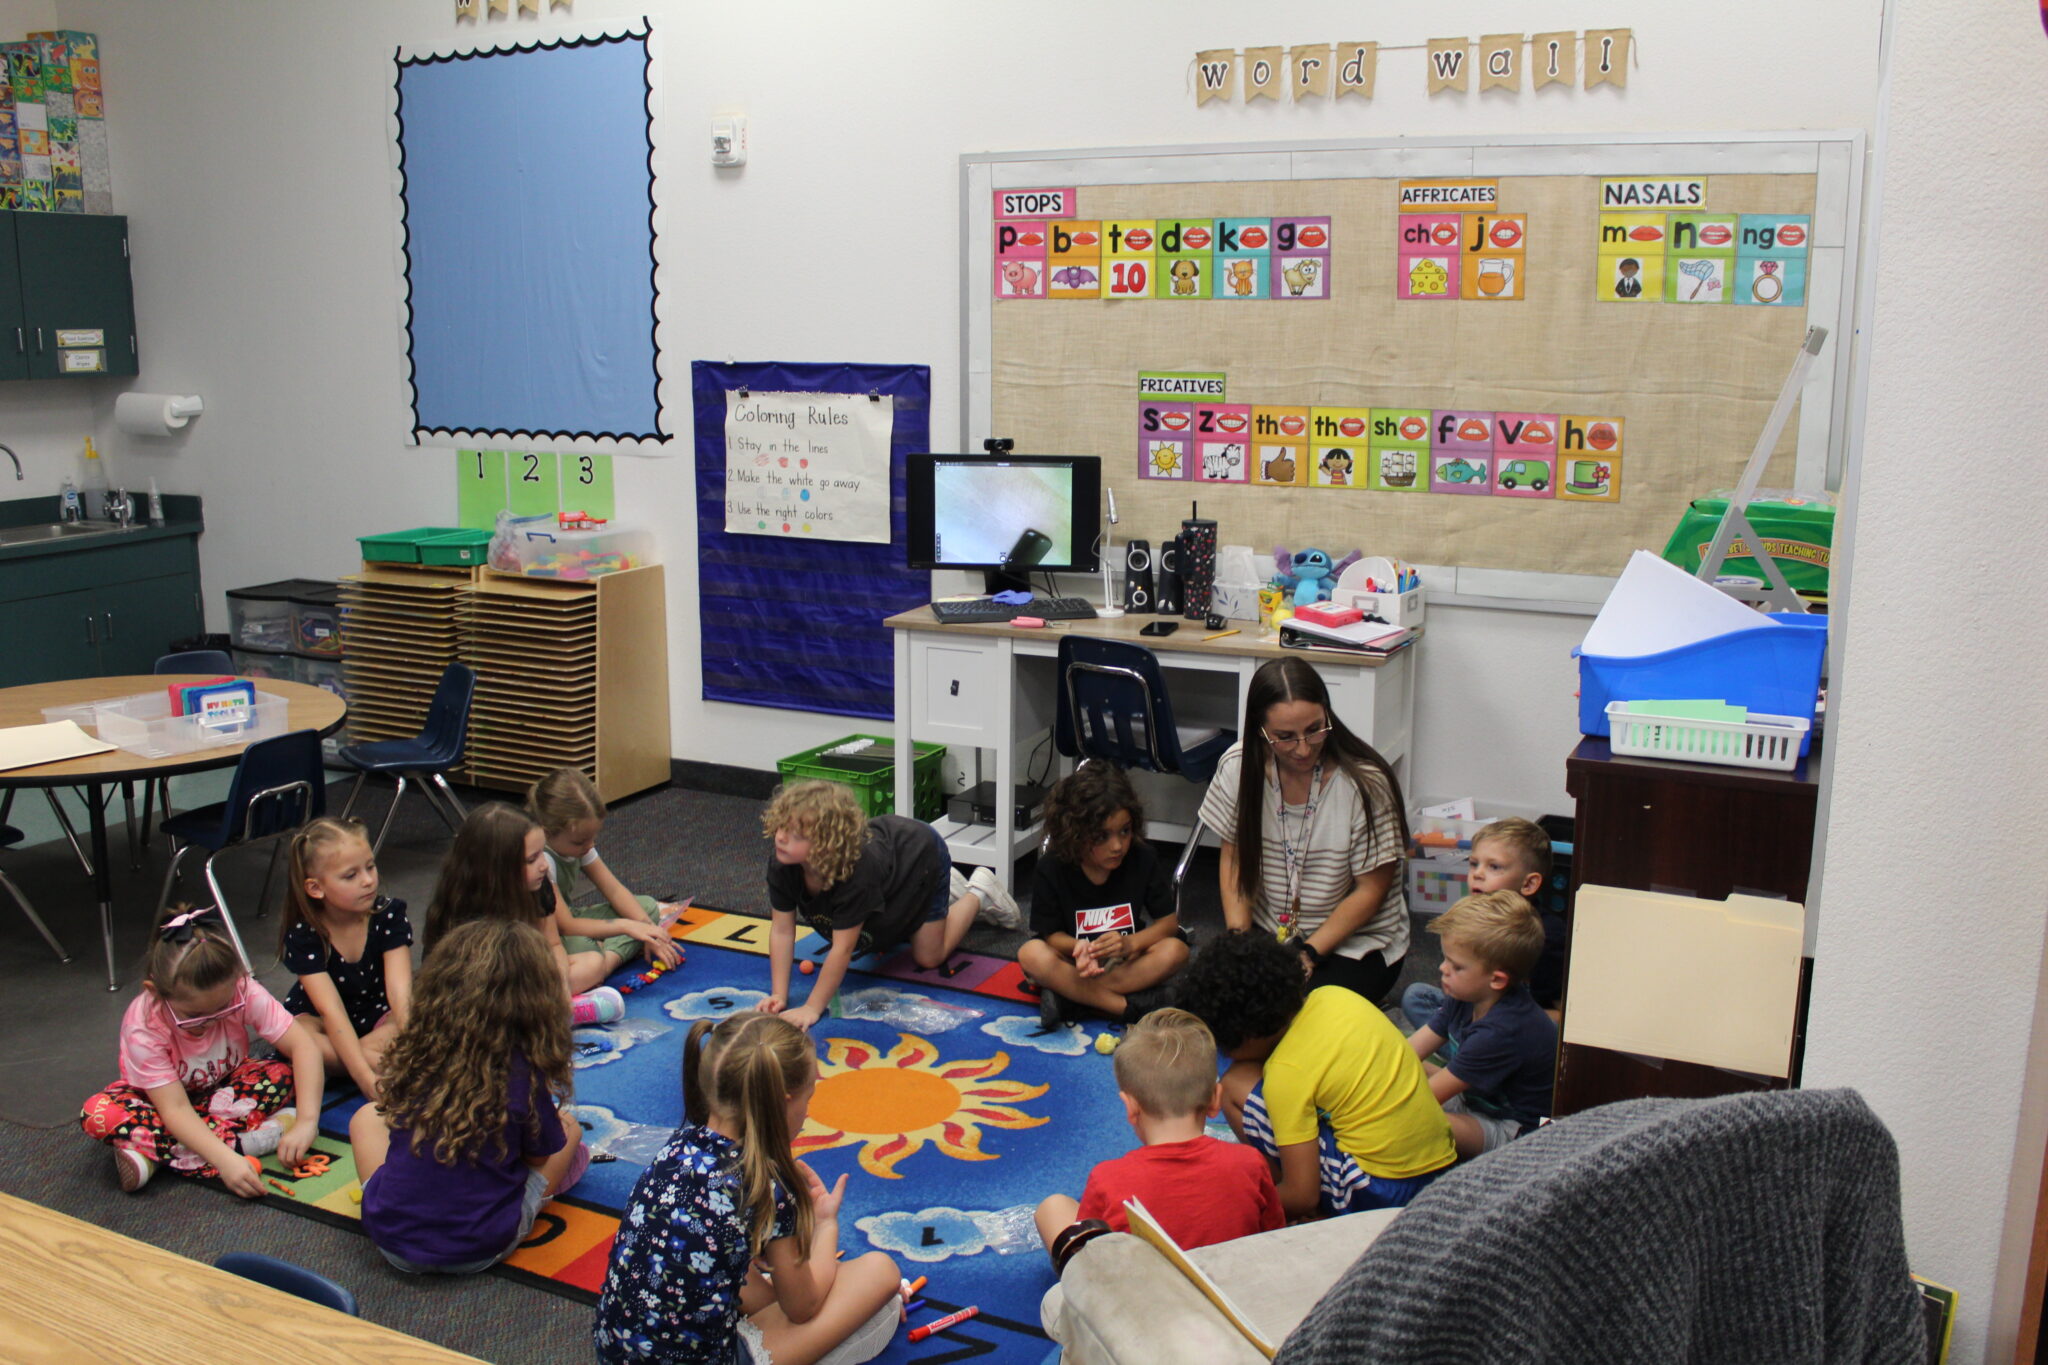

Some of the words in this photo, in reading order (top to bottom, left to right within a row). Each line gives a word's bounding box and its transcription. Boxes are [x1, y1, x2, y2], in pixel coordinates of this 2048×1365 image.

[1201, 48, 1366, 88] word
[1432, 37, 1612, 78] wall
[1005, 194, 1062, 213] STOPS
[1402, 187, 1496, 203] AFFRICATES
[1605, 183, 1701, 205] NASALS
[999, 226, 1018, 254] p
[1053, 226, 1072, 253] b
[1108, 224, 1122, 253] t
[1161, 222, 1181, 253] d
[1219, 222, 1240, 252] k
[1277, 223, 1296, 251] g
[1404, 225, 1430, 243] ch
[1470, 216, 1485, 251] j
[1603, 226, 1627, 243] m
[1674, 220, 1697, 249] n
[1743, 228, 1775, 249] ng
[1111, 262, 1147, 294] 10
[1140, 378, 1223, 394] FRICATIVES
[735, 403, 796, 430] Coloring
[808, 405, 849, 426] Rules
[1255, 414, 1279, 435] th
[1315, 416, 1339, 437] th
[1374, 417, 1399, 436] sh
[1438, 415, 1456, 444] f
[1565, 420, 1585, 450] h
[738, 437, 762, 453] Stay
[769, 443, 778, 452] in
[784, 439, 800, 452] the
[808, 440, 829, 453] lines
[478, 452, 484, 479] 1
[523, 454, 540, 482] 2
[579, 456, 595, 485] 3
[737, 470, 761, 484] Make
[768, 470, 783, 484] the
[789, 472, 814, 486] white
[820, 479, 830, 491] go
[834, 479, 861, 492] away
[737, 502, 752, 515] Use
[757, 502, 771, 516] the
[775, 506, 798, 521] right
[805, 506, 834, 521] colors
[1779, 542, 1817, 559] TEACHING
[221, 698, 245, 708] MATH
[1083, 907, 1117, 927] NIKE
